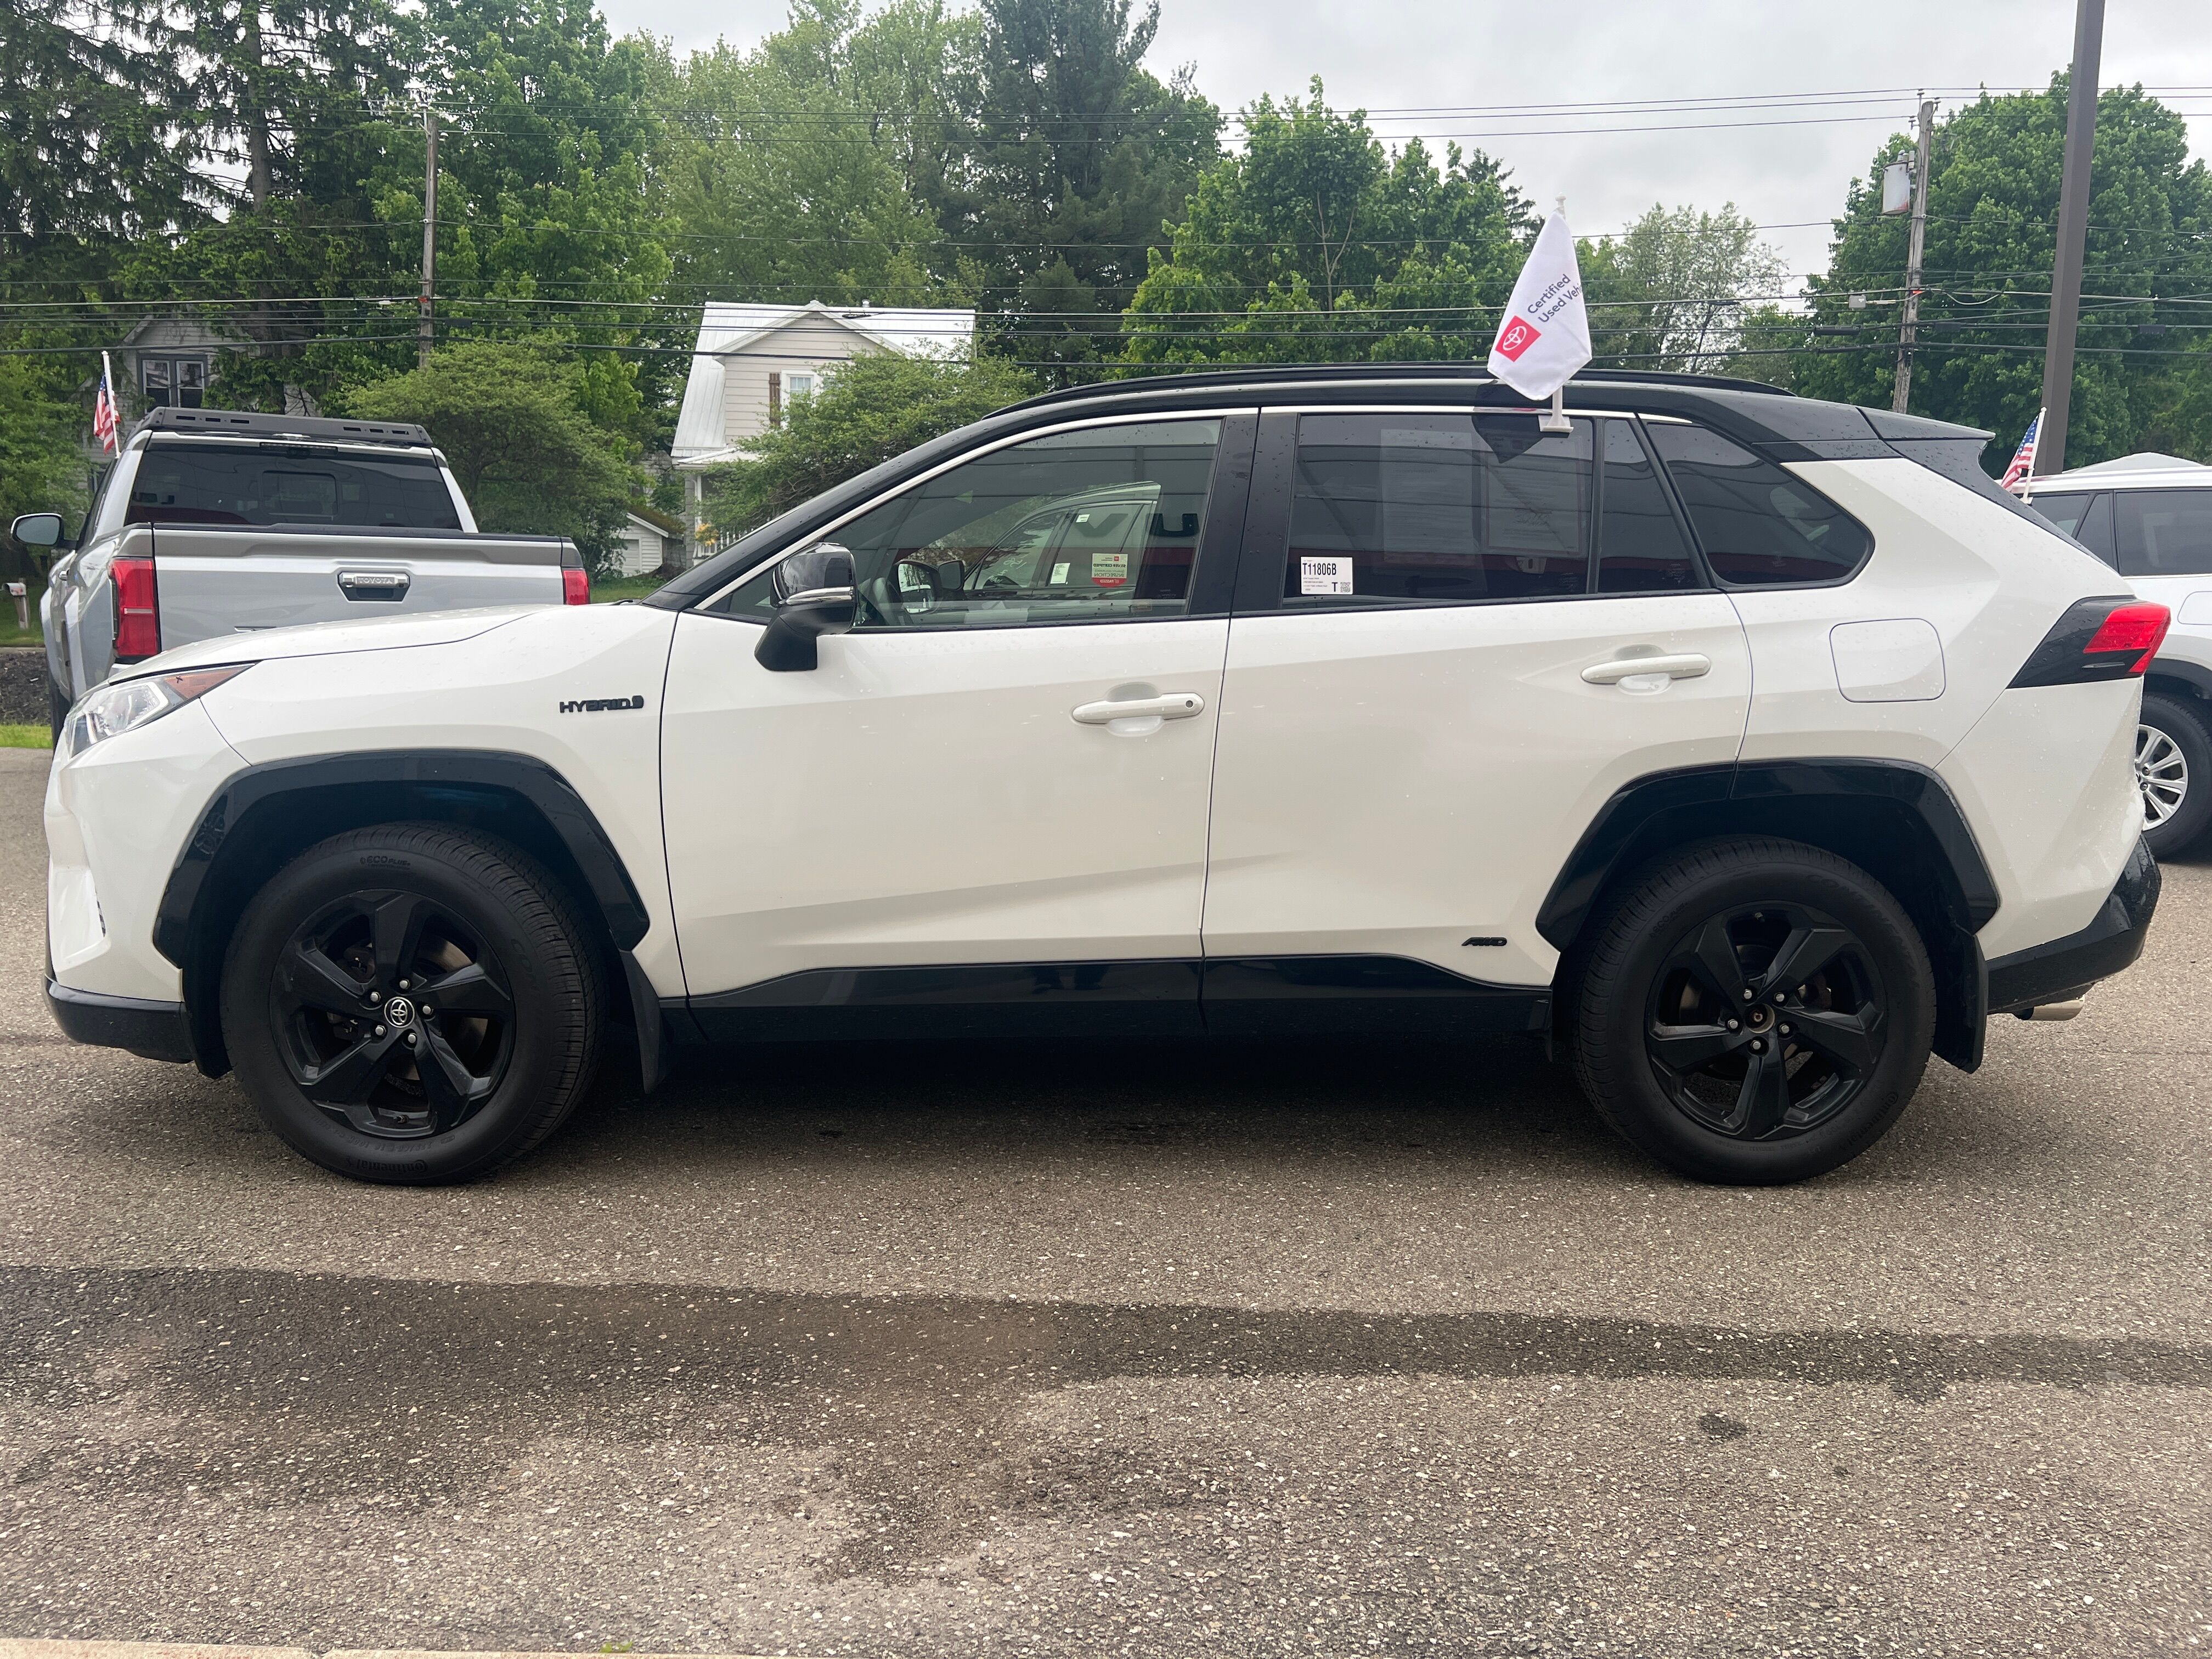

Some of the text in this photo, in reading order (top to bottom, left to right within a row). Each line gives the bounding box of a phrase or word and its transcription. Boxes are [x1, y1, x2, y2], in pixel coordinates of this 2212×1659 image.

[1527, 273, 1571, 314] Certified
[1538, 297, 1567, 323] Used
[1302, 563, 1336, 575] T11806B
[1331, 582, 1338, 592] T
[560, 698, 631, 713] HYBRID
